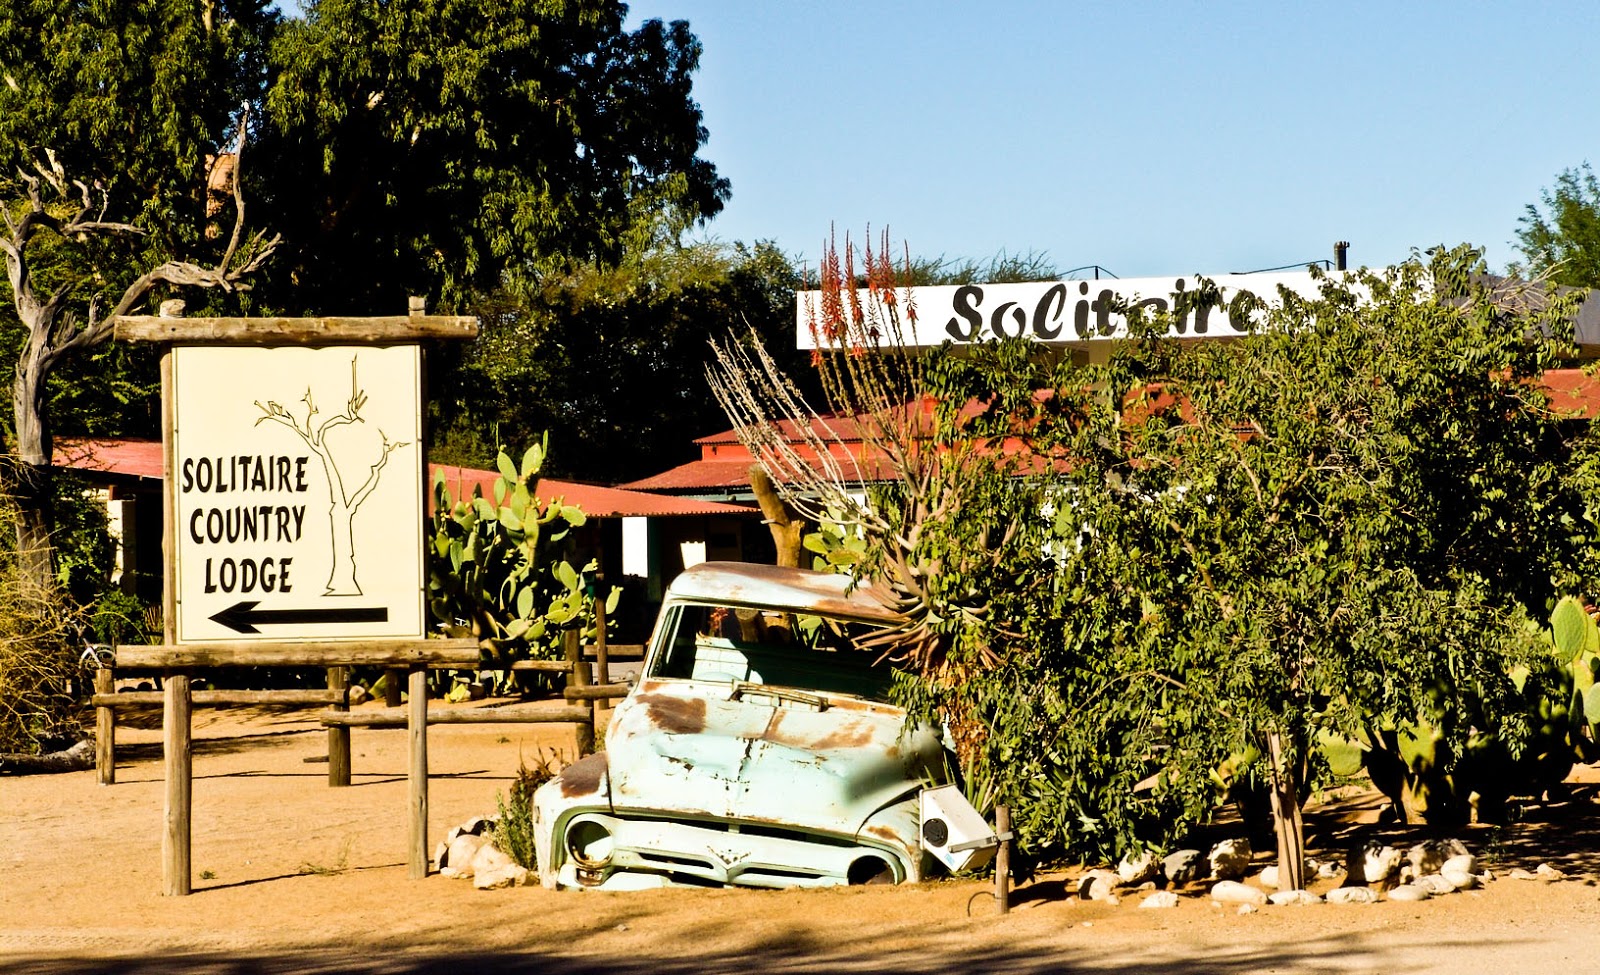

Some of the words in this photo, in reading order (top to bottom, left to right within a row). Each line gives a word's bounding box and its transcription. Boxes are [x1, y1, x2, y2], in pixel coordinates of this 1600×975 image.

[183, 455, 309, 493] SOLITAIRE
[190, 505, 306, 544] COUNTRY
[204, 557, 293, 594] LODGE
